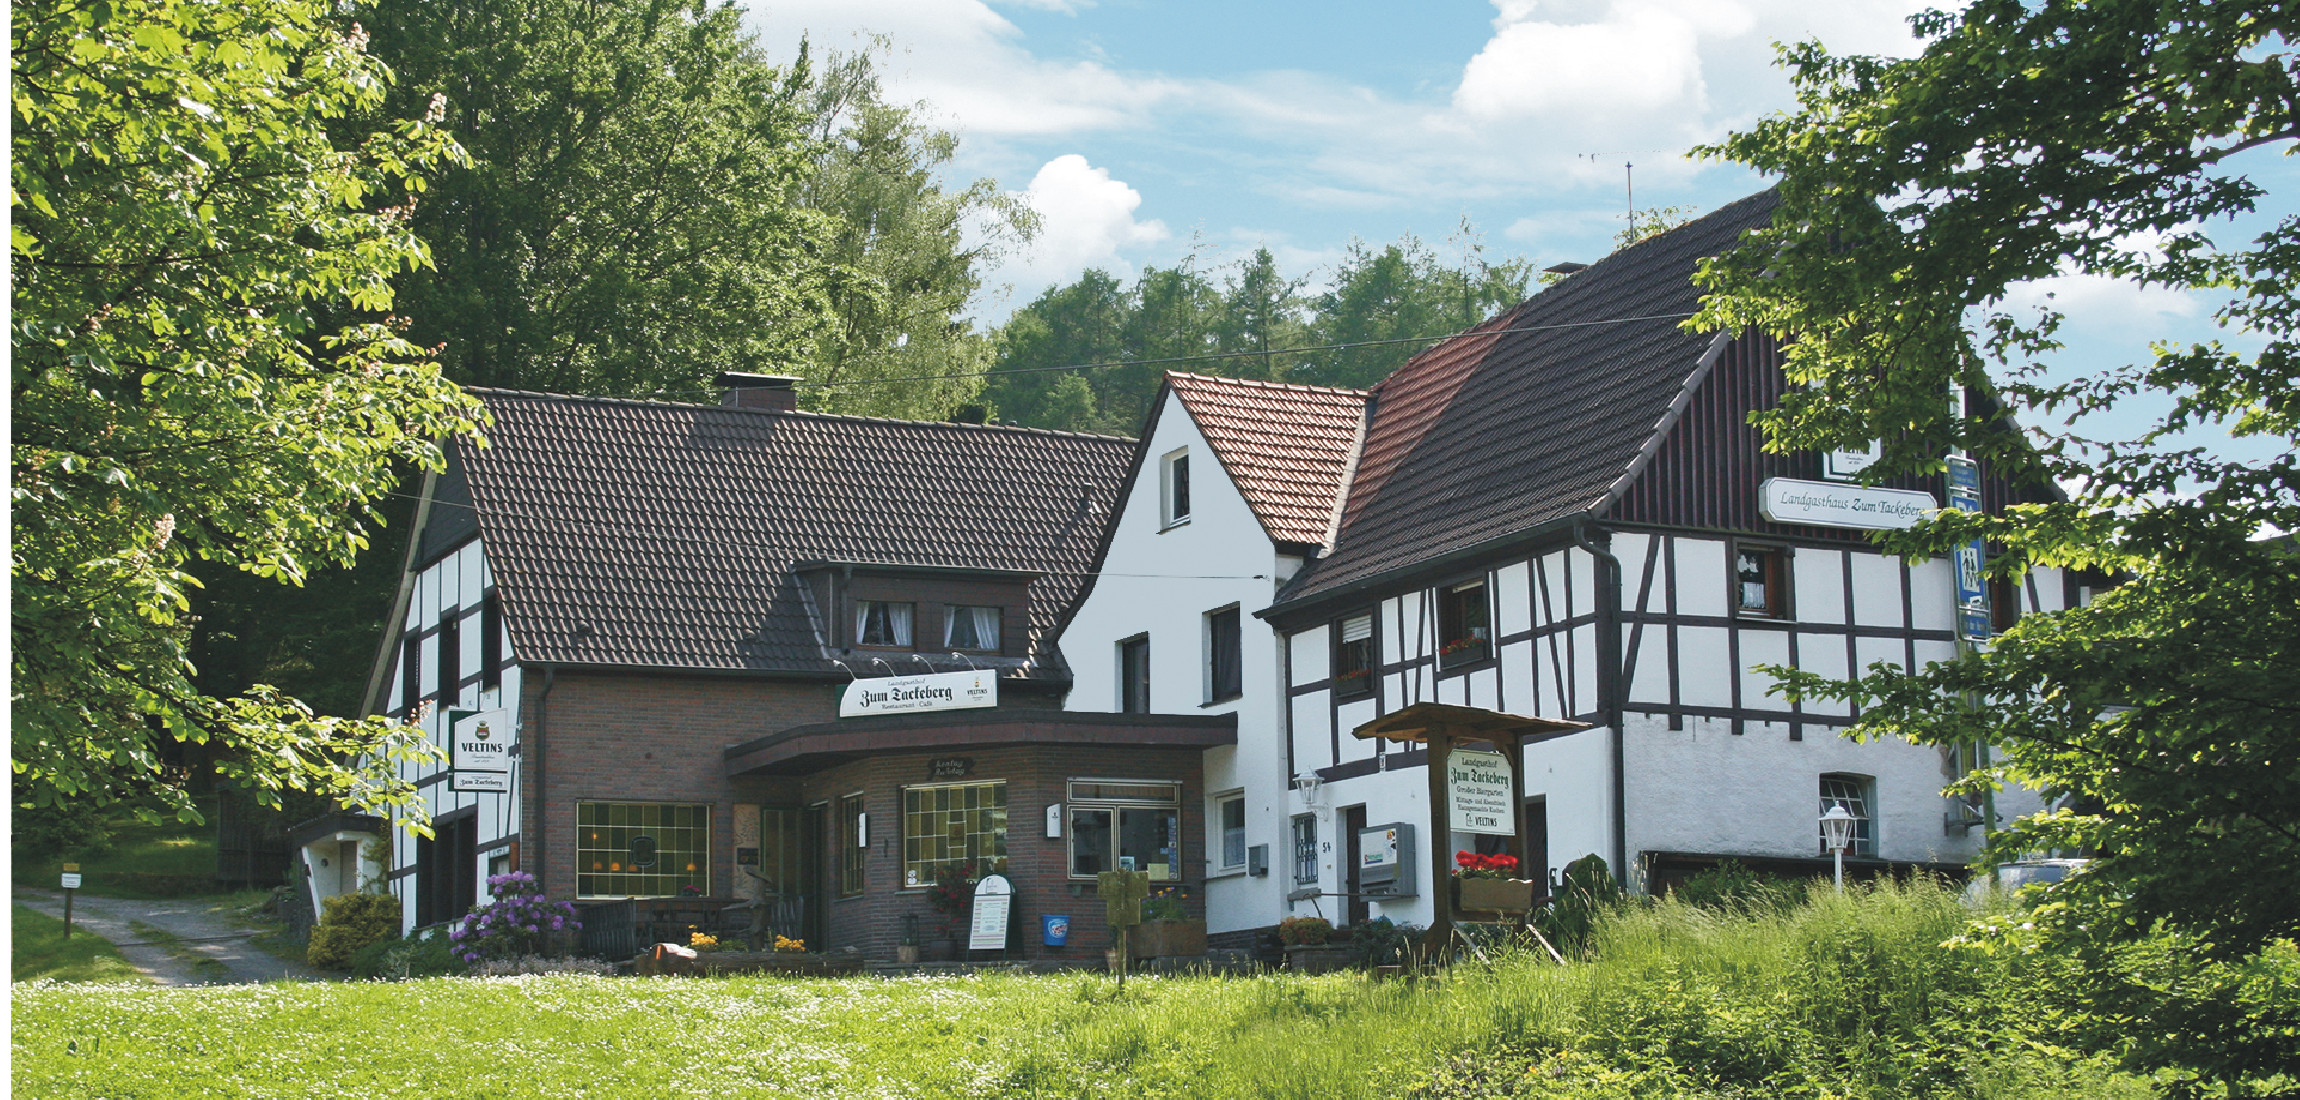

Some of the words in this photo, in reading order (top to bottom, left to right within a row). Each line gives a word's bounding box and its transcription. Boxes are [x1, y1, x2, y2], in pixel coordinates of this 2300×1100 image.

[1780, 491, 1848, 511] Landgasthaus
[1851, 498, 1876, 512] Zum
[1878, 500, 1925, 522] Tackeberg
[860, 690, 888, 708] Zum
[892, 685, 953, 701] Tackeberg
[967, 688, 988, 696] VELTINS
[461, 742, 503, 753] VELTINS
[1451, 767, 1469, 784] Zum
[1471, 769, 1509, 789] Tackeberg
[1475, 816, 1497, 827] VELTINS
